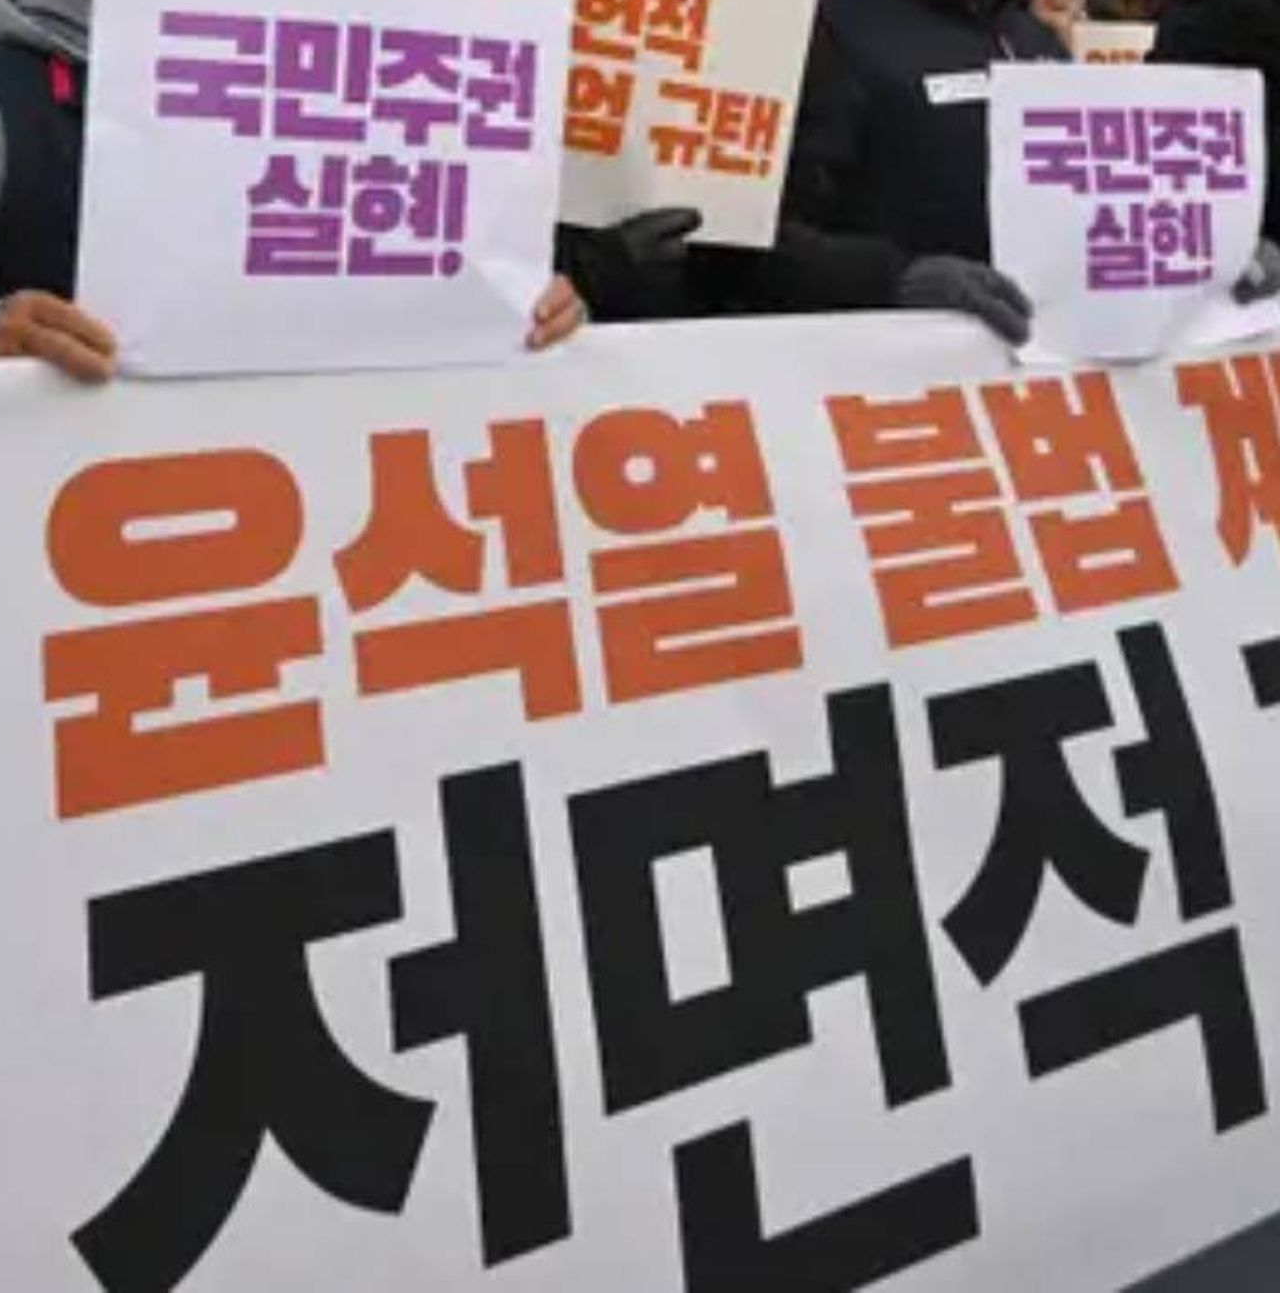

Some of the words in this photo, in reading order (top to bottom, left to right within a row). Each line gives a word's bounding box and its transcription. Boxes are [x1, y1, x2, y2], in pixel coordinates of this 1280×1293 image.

[155, 10, 538, 152] 국민주권
[562, 65, 635, 156] 엄
[649, 81, 787, 179] 규탄!
[1022, 108, 1247, 194] 국민주권
[243, 154, 469, 279] 실현!
[1085, 200, 1214, 291] 실현!
[41, 398, 804, 820] 윤석열
[825, 369, 1181, 650] 불법
